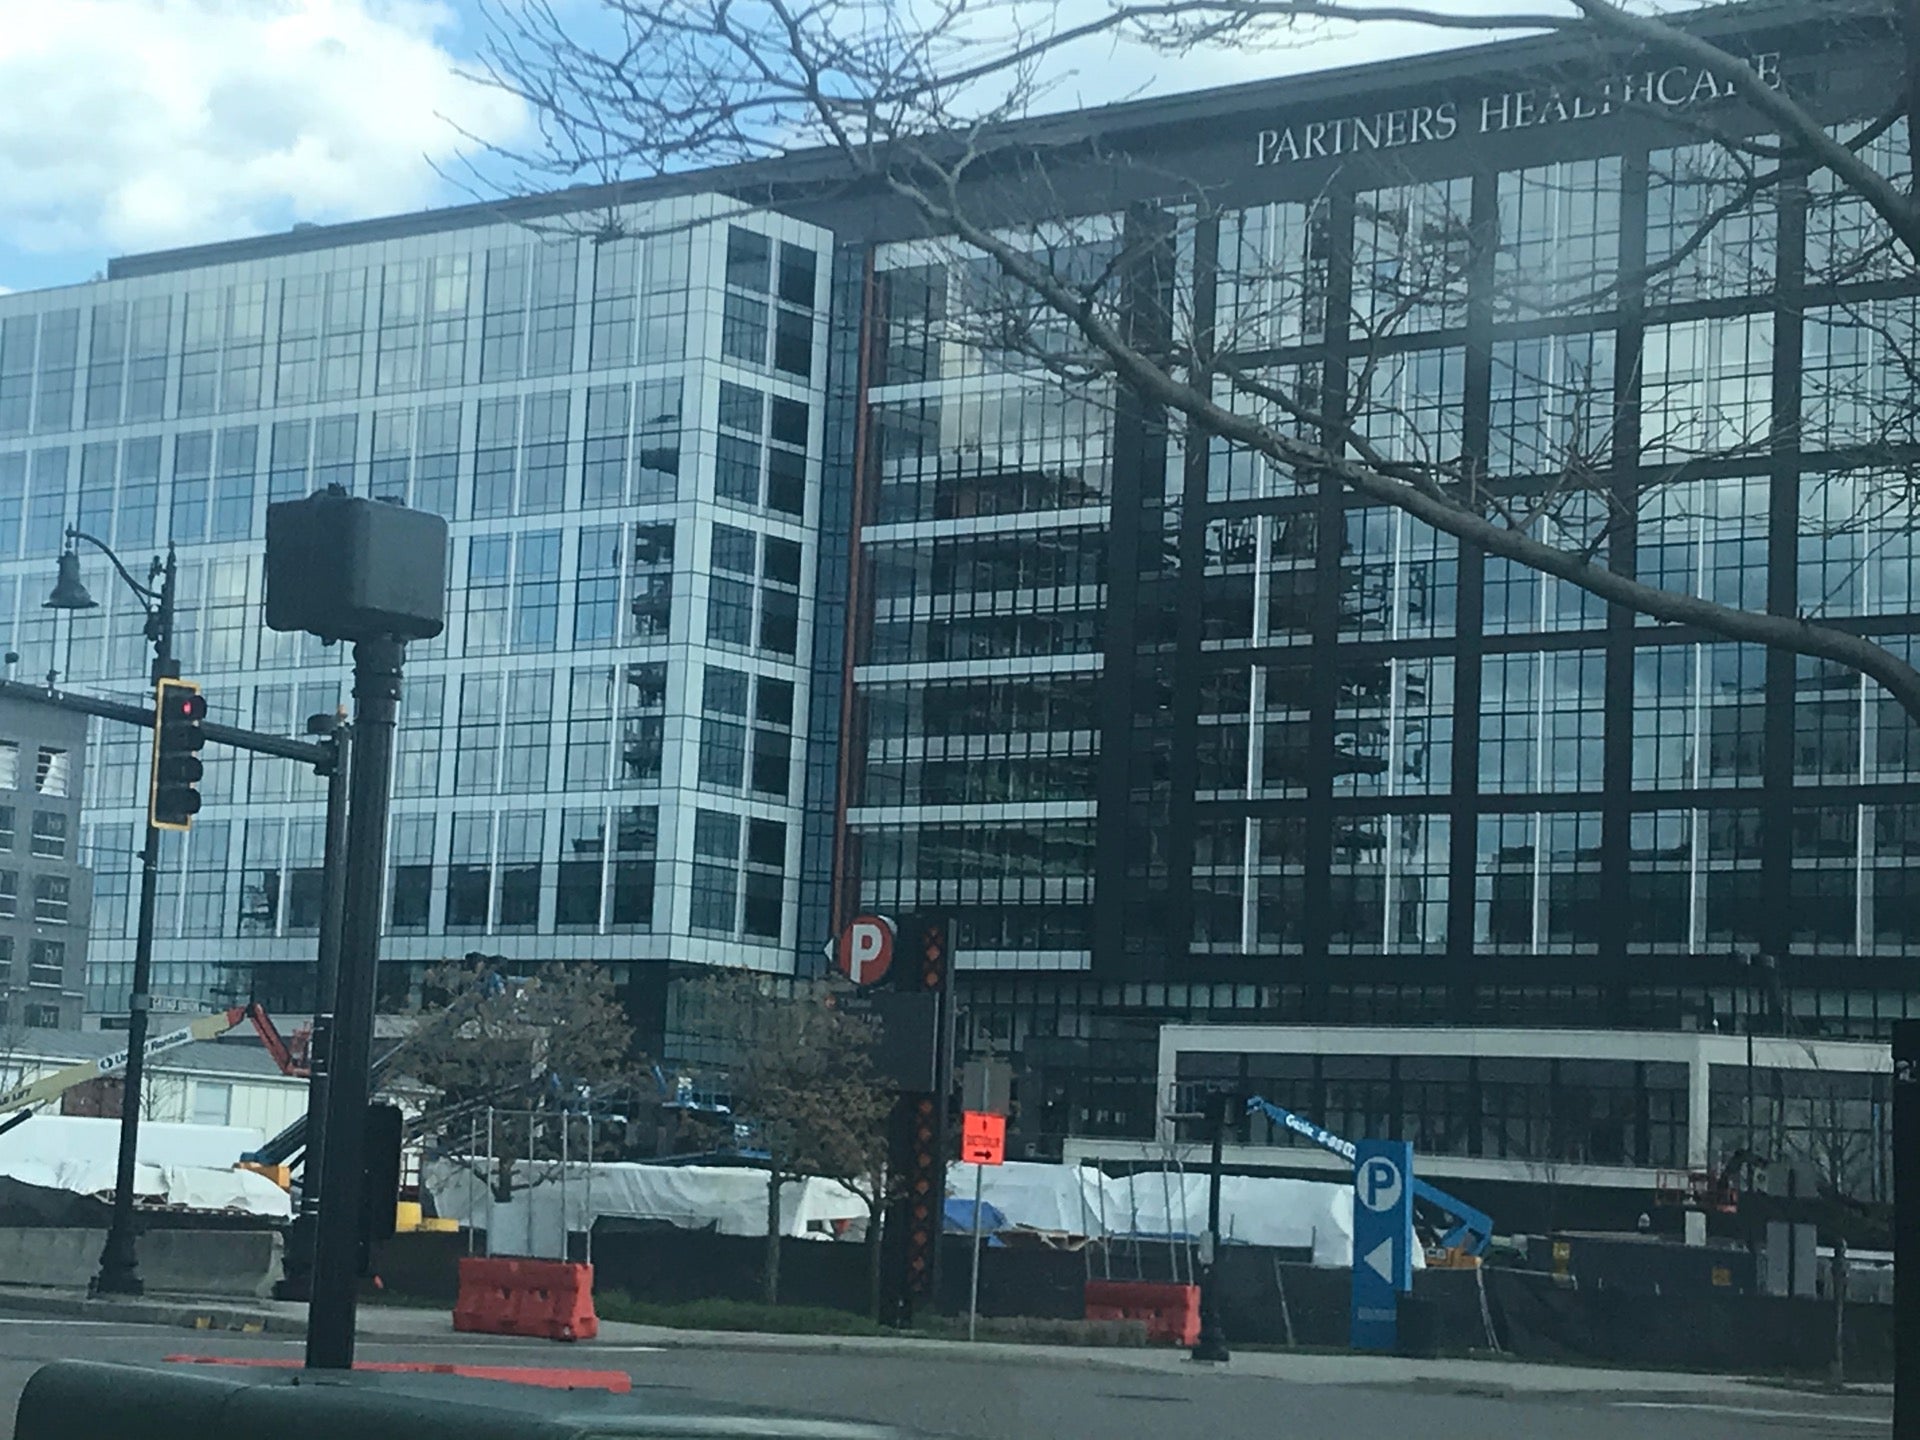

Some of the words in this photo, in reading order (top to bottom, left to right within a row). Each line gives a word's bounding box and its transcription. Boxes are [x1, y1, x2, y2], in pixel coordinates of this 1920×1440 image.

[1255, 102, 1456, 166] PARTNERS
[1478, 52, 1781, 133] HEALTHCAE
[850, 924, 883, 983] P
[1369, 1164, 1395, 1206] P
